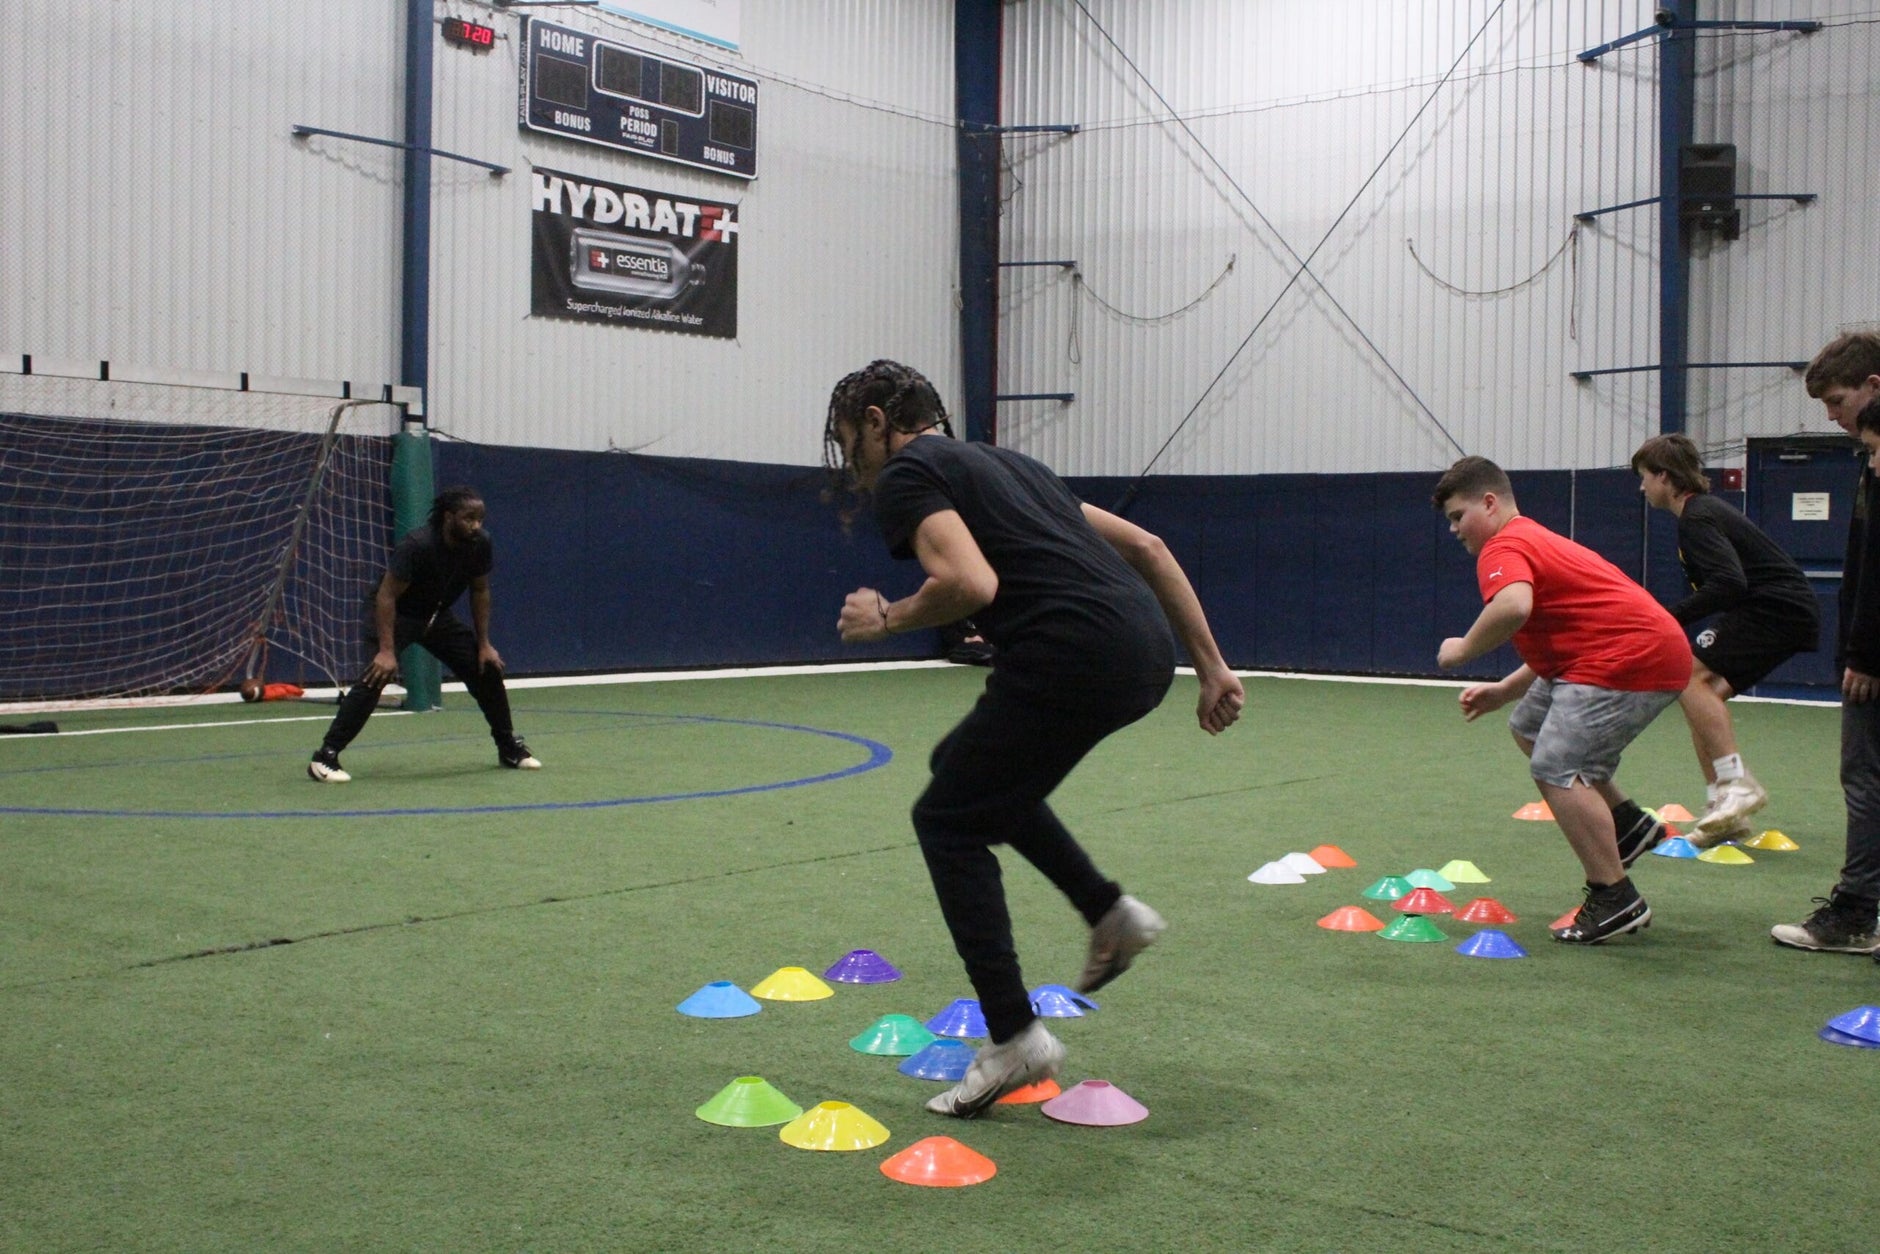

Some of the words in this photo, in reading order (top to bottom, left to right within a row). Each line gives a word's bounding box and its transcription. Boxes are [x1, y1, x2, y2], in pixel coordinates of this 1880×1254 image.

[540, 28, 584, 57] HOME
[707, 74, 756, 104] VISITOR
[554, 110, 592, 132] BONUS
[629, 105, 650, 120] POSS
[620, 116, 658, 138] PERIOD
[703, 146, 736, 166] BONUS
[616, 254, 669, 274] essentia
[566, 298, 623, 318] Supercharged
[623, 307, 651, 319] Ionized
[651, 309, 681, 323] Alkaline
[681, 313, 704, 325] Water
